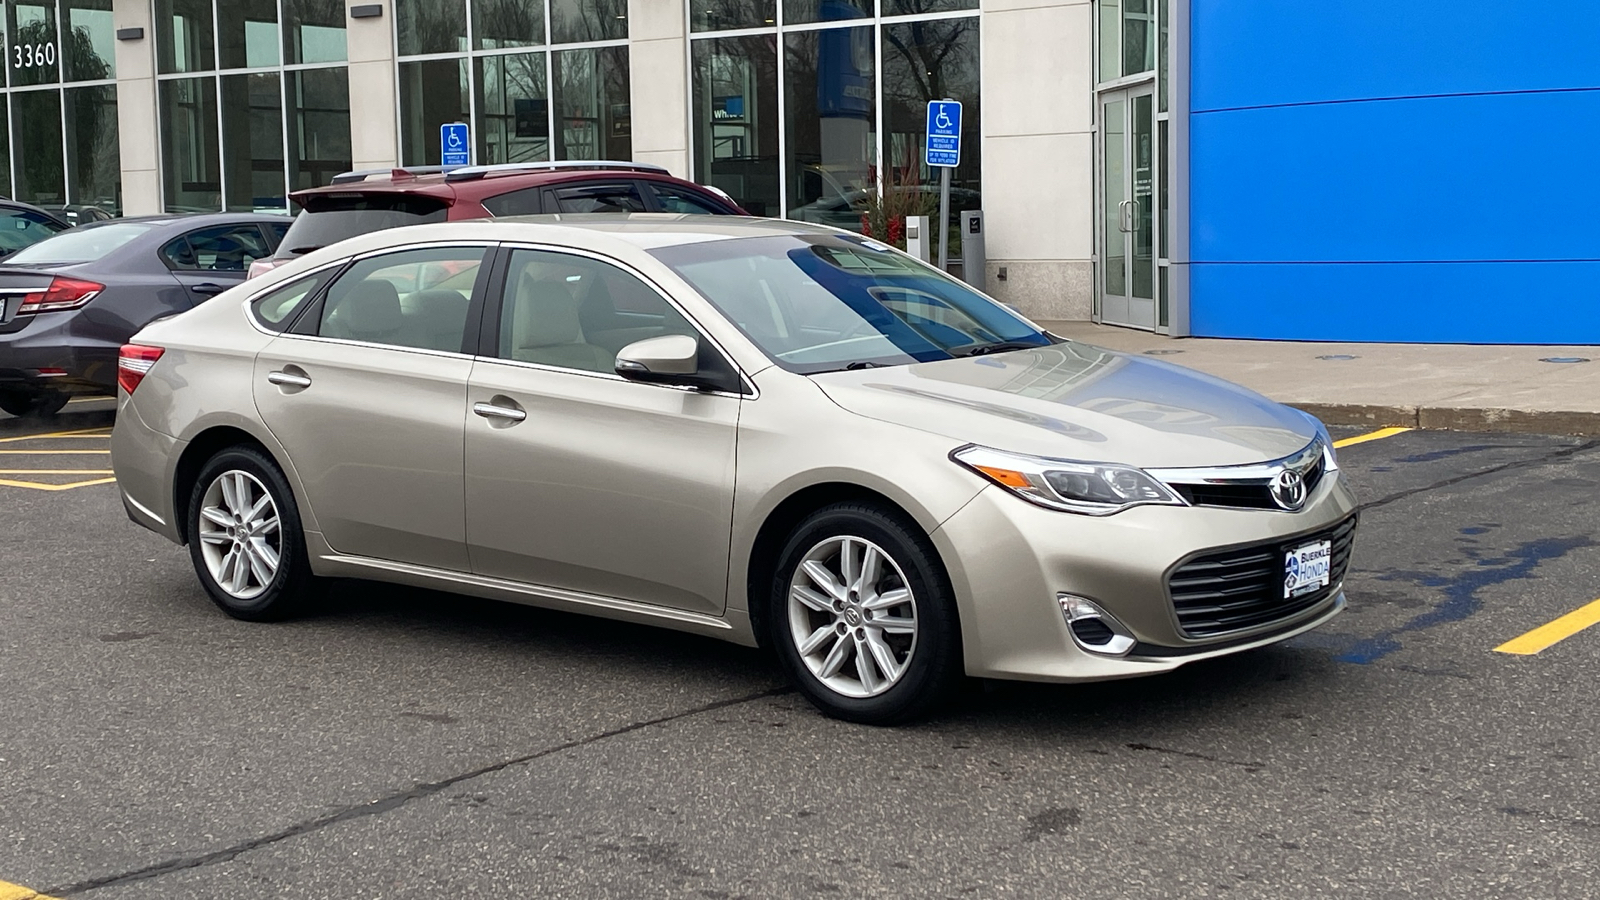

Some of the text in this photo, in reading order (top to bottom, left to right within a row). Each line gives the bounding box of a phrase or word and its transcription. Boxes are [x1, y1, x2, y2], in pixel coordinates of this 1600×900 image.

[13, 42, 55, 68] 3360
[1301, 547, 1331, 564] BUERKLE
[1300, 560, 1329, 582] HONDA
